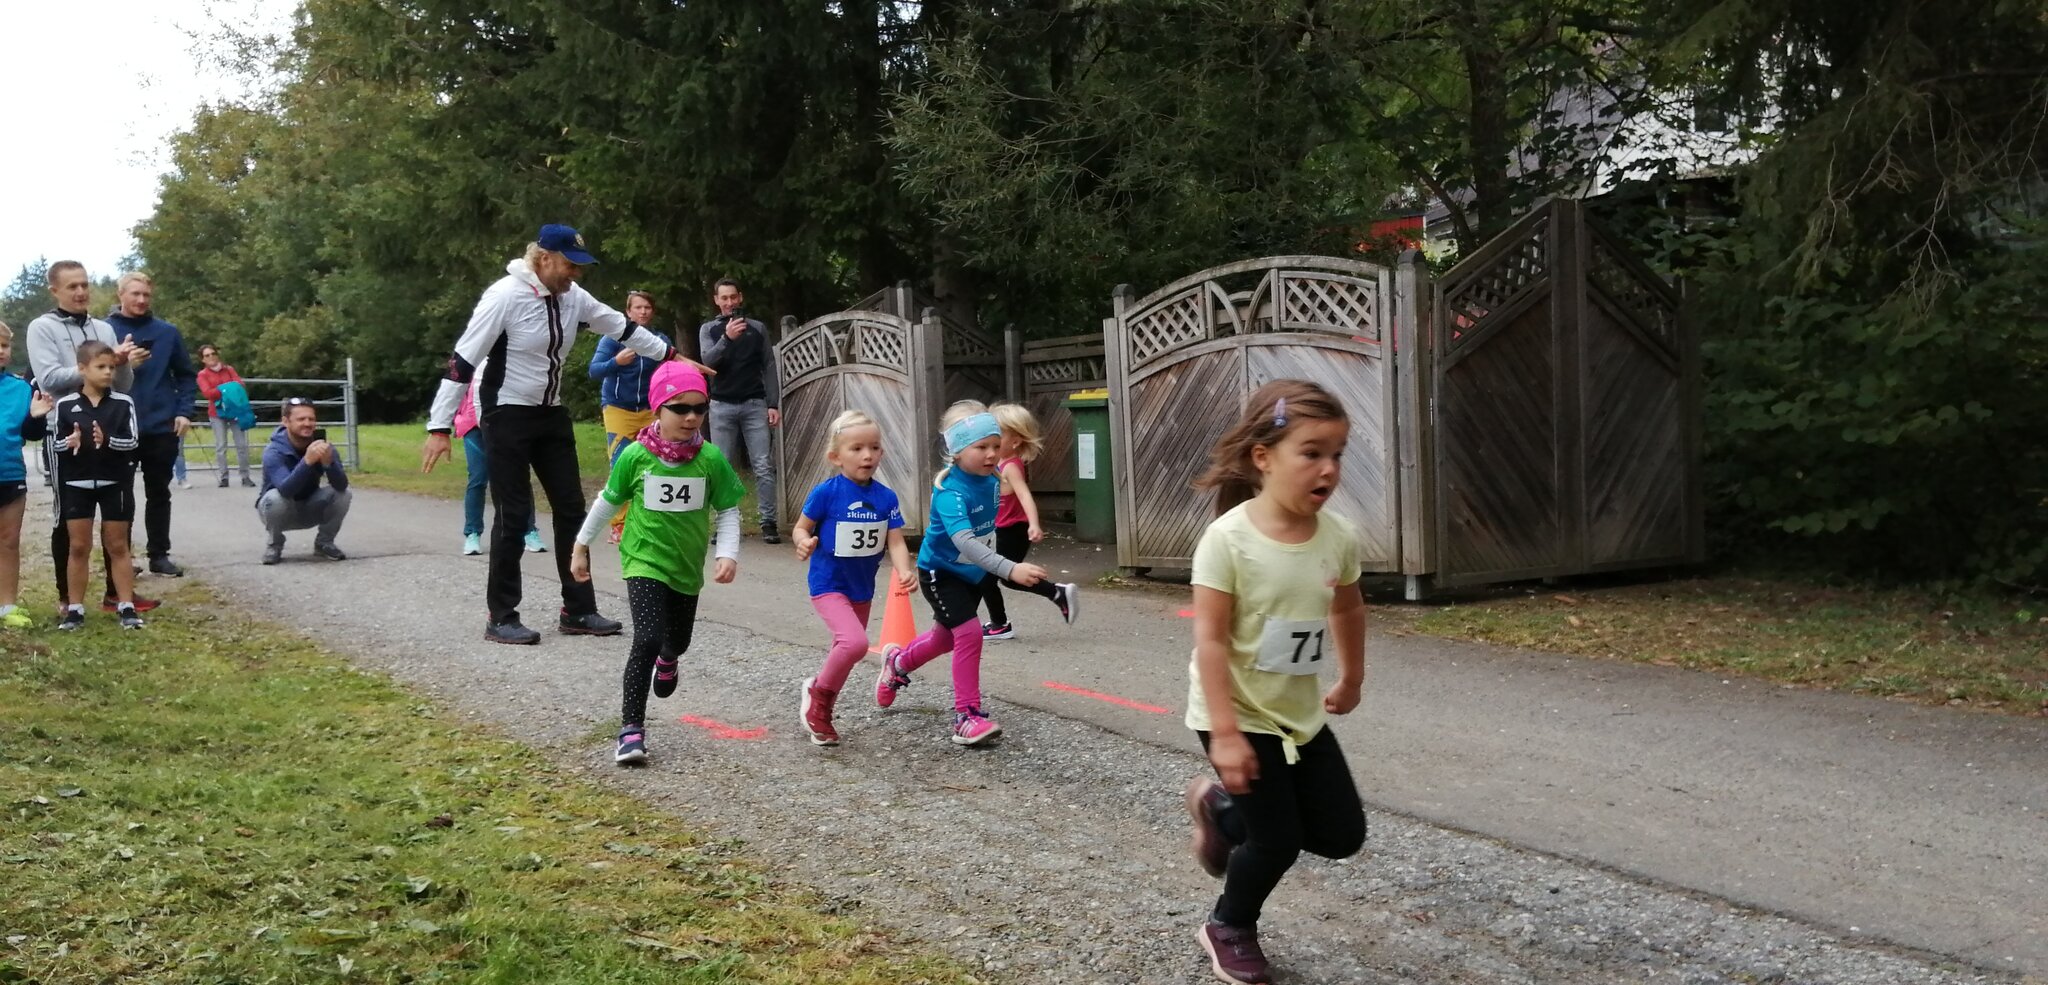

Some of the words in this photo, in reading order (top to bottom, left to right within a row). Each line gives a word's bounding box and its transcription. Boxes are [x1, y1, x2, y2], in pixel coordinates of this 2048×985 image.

[659, 483, 691, 504] 34
[846, 511, 878, 520] skinfit
[851, 528, 879, 550] 35
[1291, 628, 1324, 663] 71
